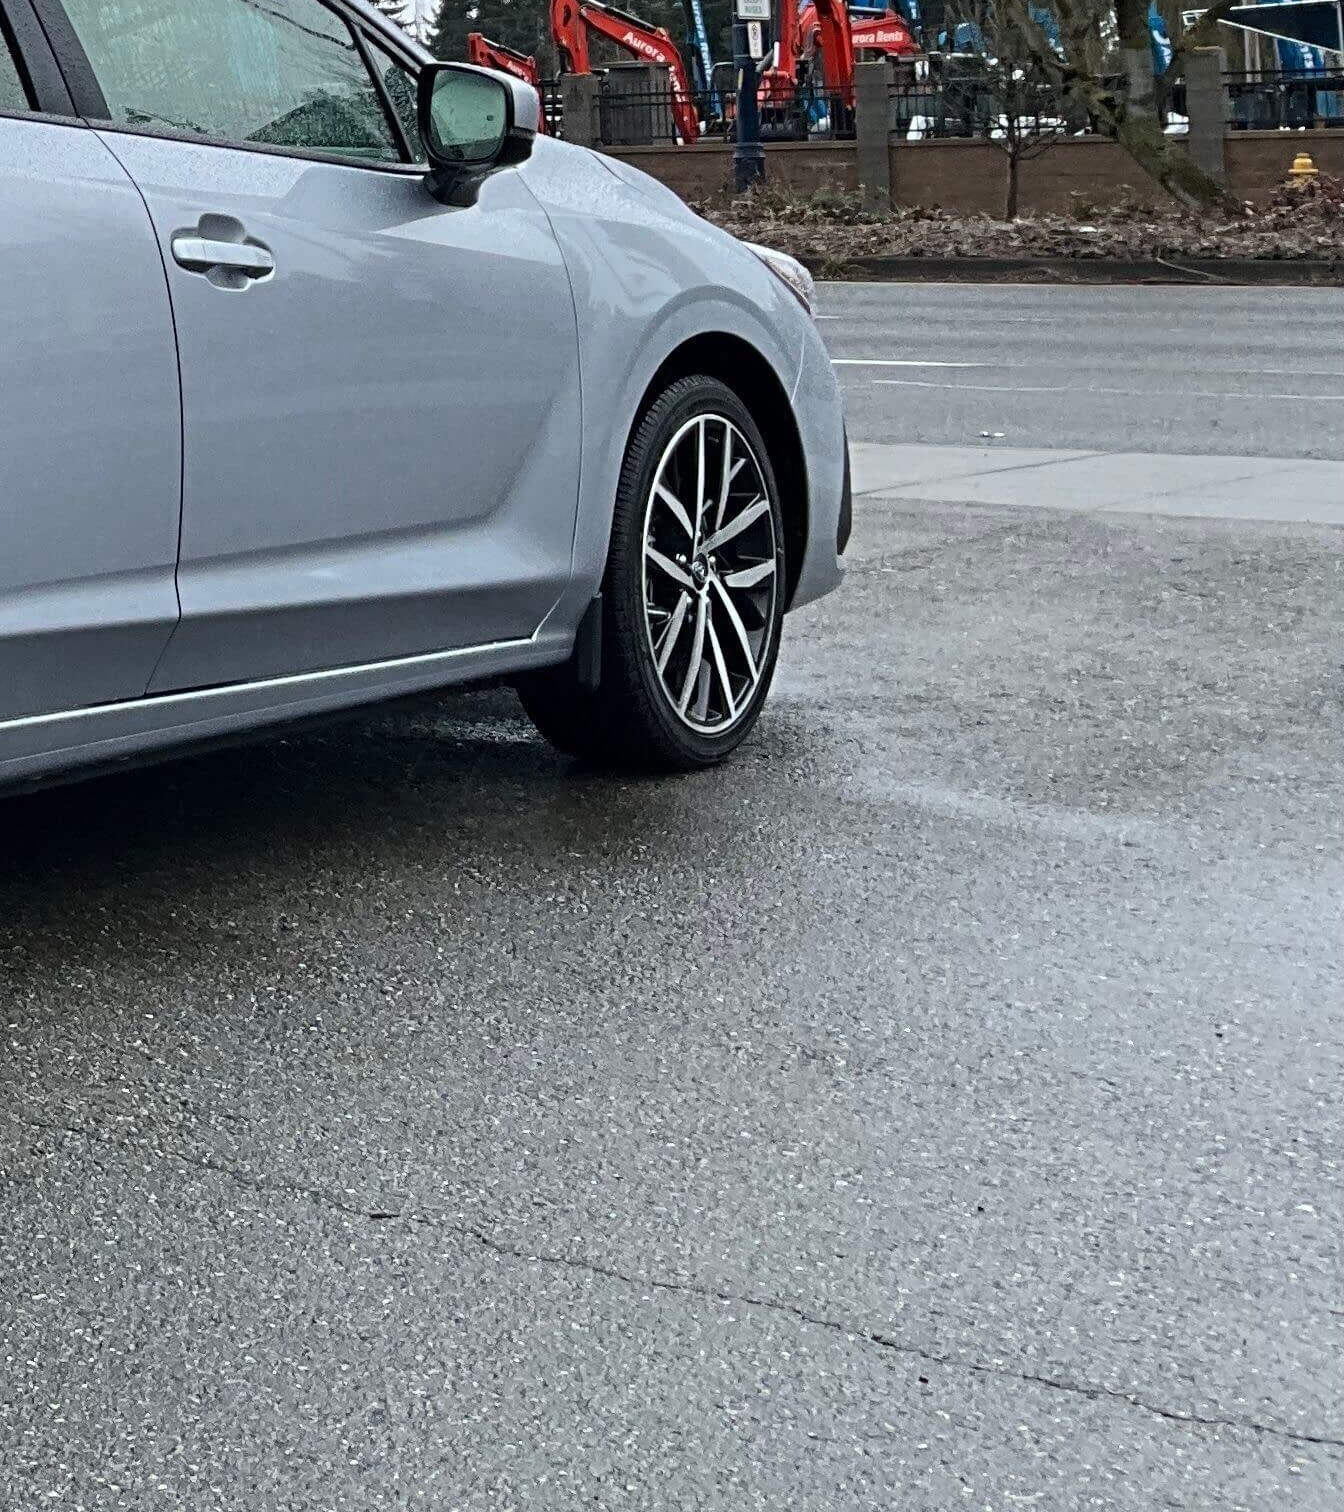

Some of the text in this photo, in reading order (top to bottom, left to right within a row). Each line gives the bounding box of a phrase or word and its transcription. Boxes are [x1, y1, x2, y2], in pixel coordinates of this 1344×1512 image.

[623, 31, 666, 63] Aurora
[852, 30, 904, 43] urora Rents
